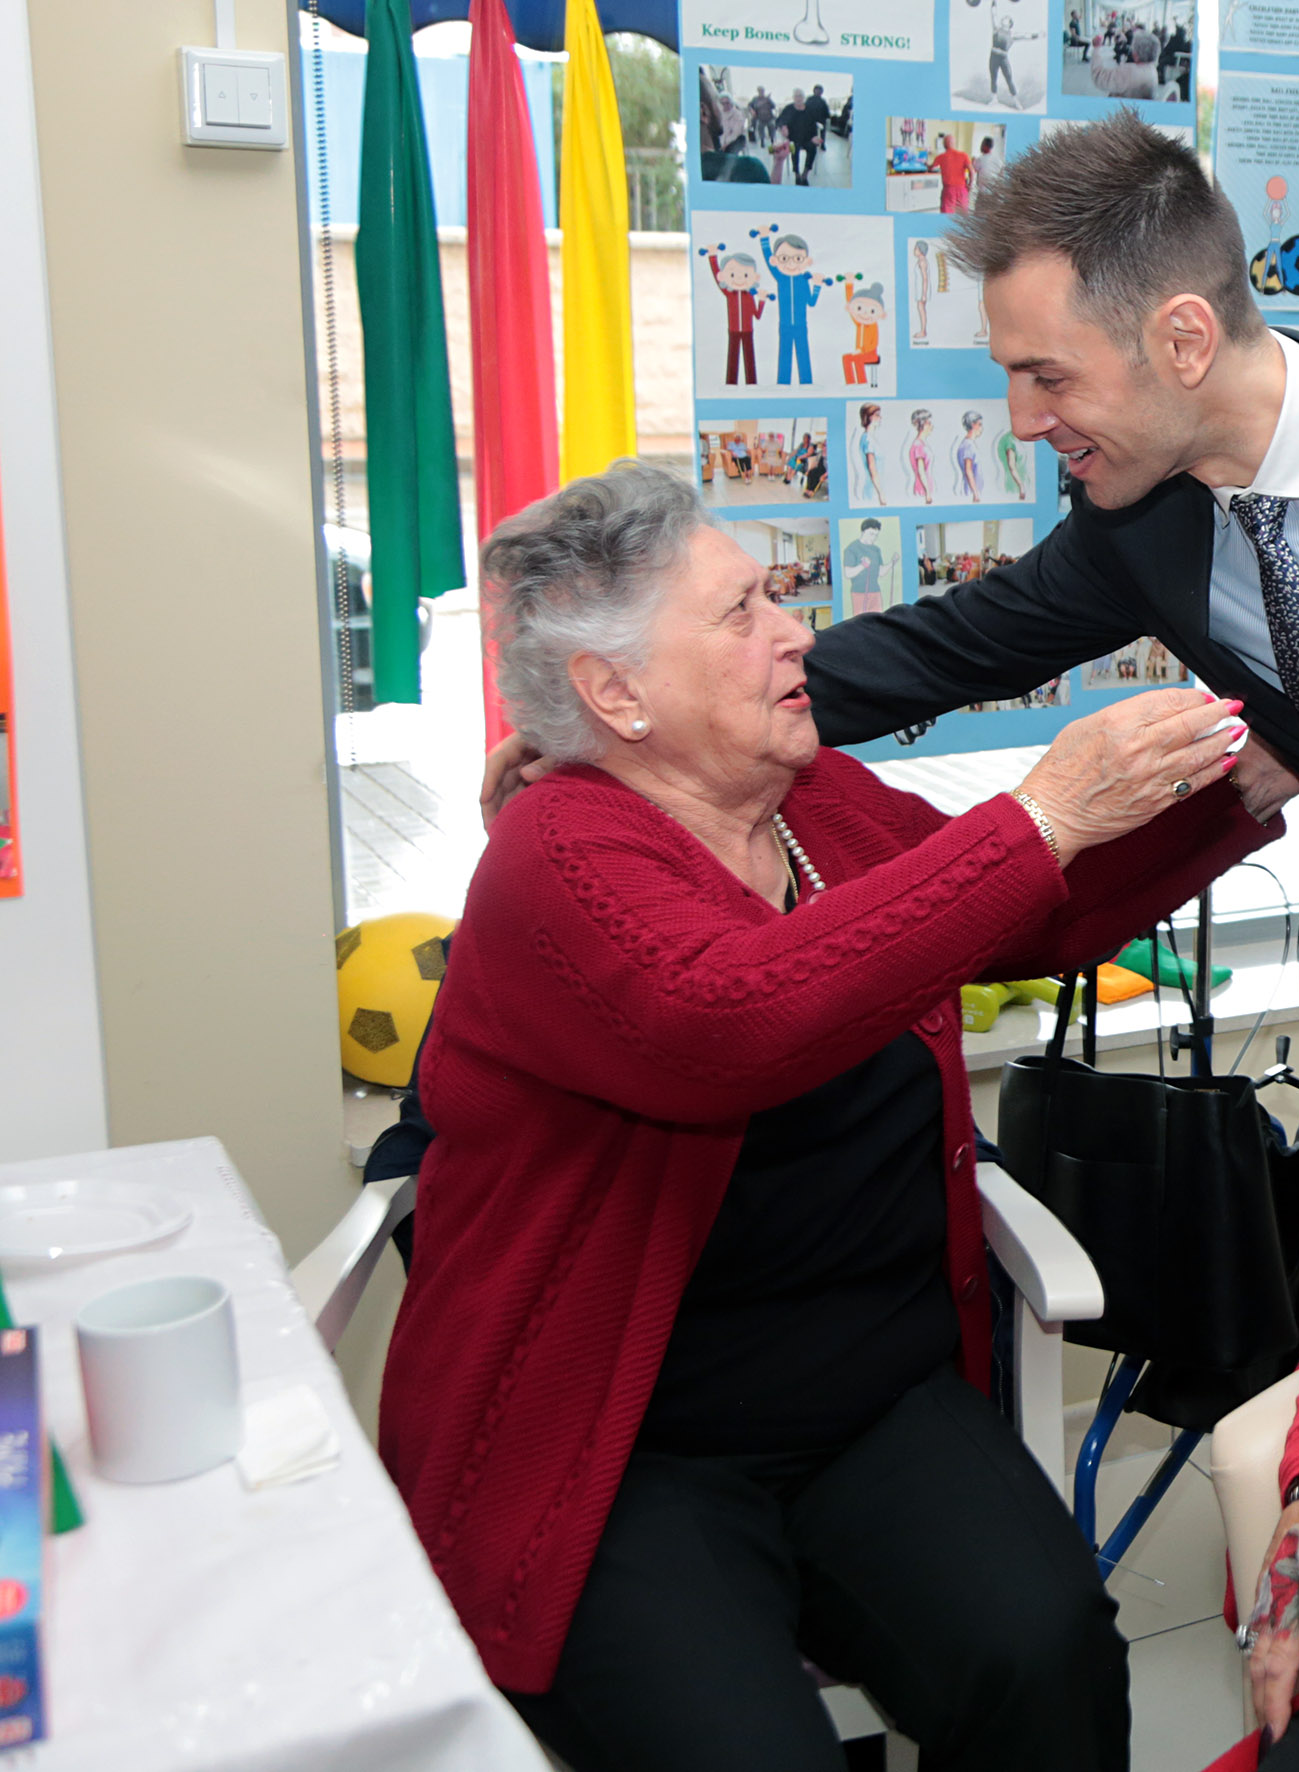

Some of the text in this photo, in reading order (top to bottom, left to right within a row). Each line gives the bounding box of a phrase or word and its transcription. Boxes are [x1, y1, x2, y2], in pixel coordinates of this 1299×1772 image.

[701, 23, 791, 42] Keep Bones
[840, 33, 912, 49] STRONG!
